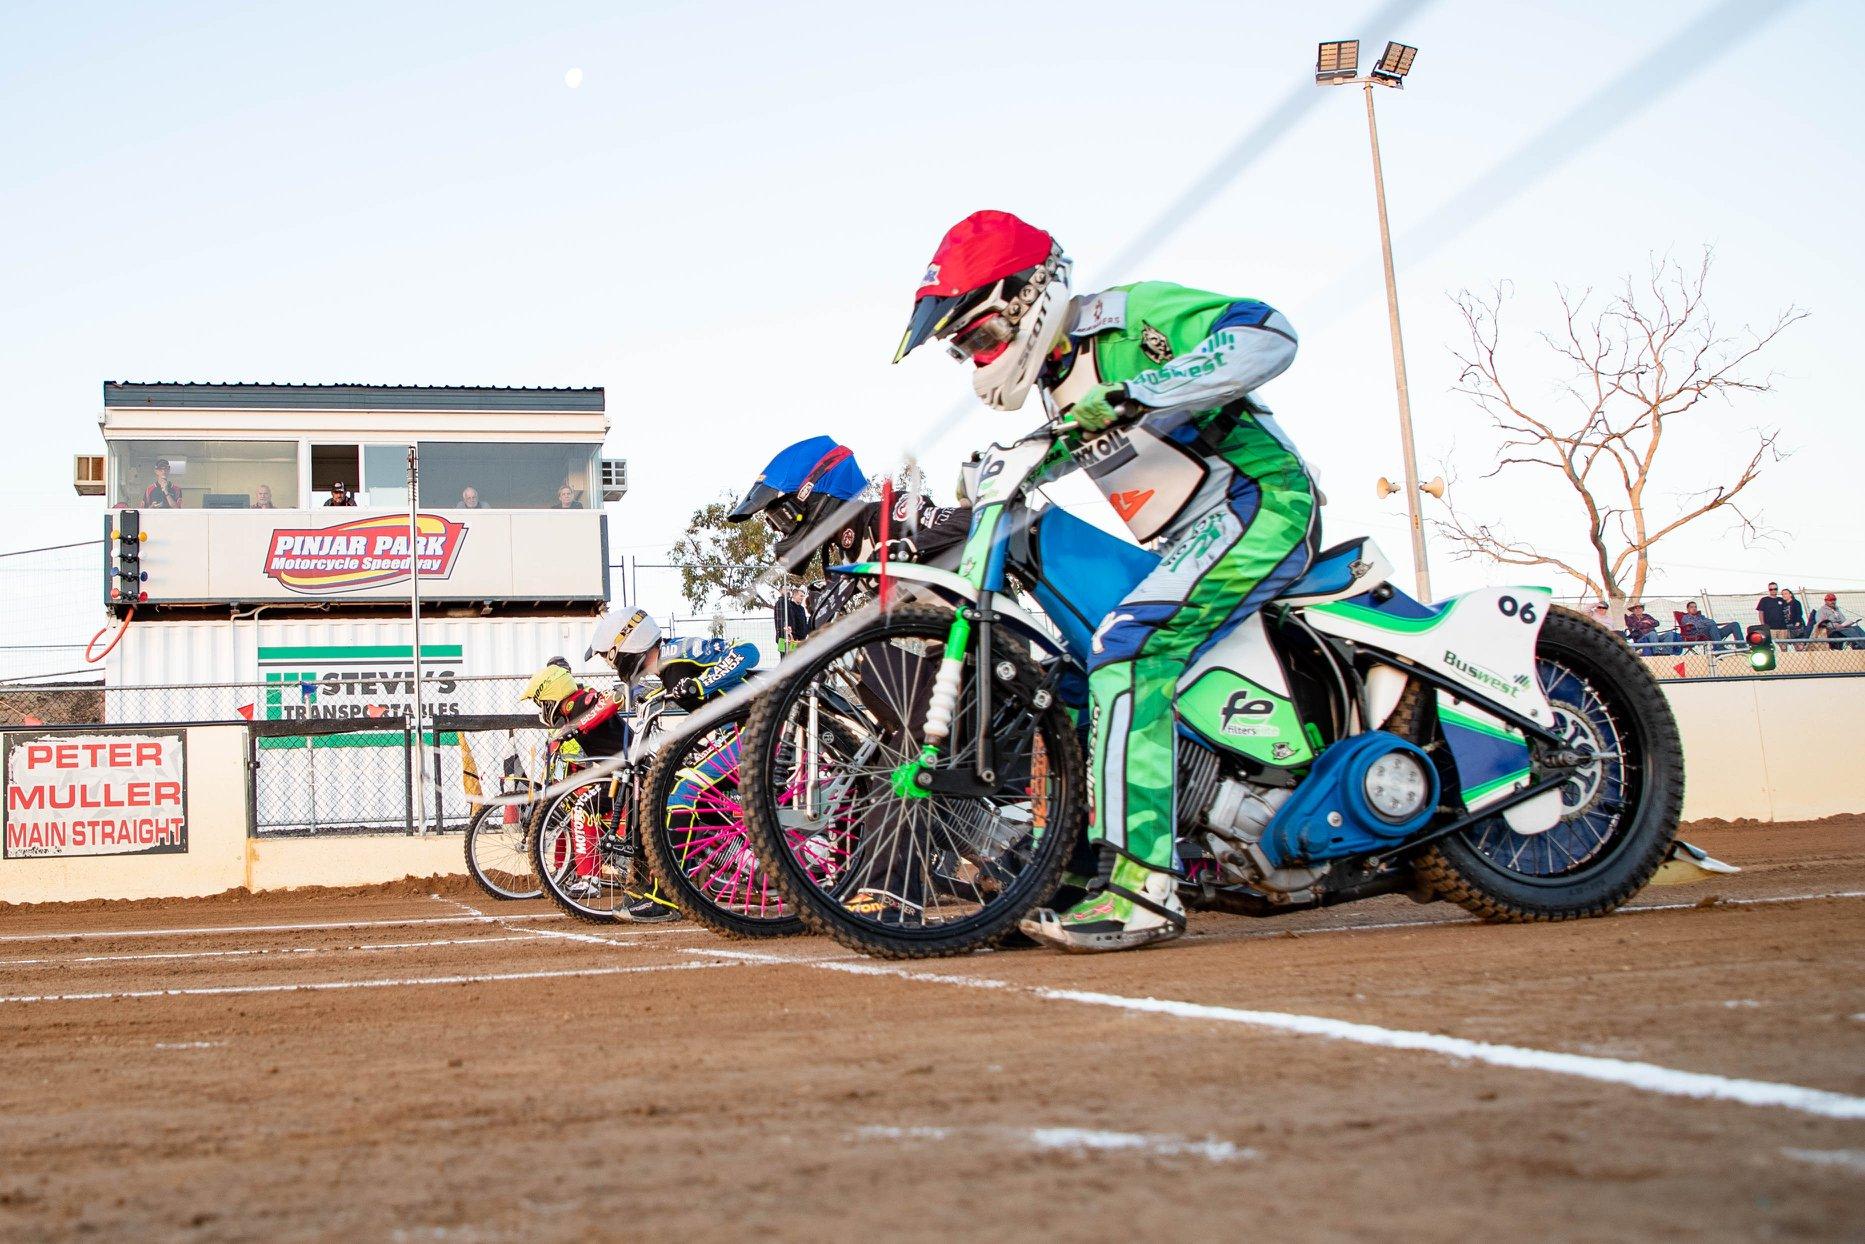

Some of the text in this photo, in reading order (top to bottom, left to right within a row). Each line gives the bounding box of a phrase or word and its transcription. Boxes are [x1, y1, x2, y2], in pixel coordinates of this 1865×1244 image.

[1097, 428, 1130, 458] OIL
[274, 535, 368, 556] PINJAR
[270, 557, 442, 571] Motorcycle Speeday
[1497, 595, 1537, 625] 06
[702, 655, 745, 688] HONDA
[1443, 650, 1521, 698] Buswest
[27, 742, 163, 770] PETER
[9, 781, 182, 811] MULLER
[8, 817, 184, 849] MAIN STRAIGHT
